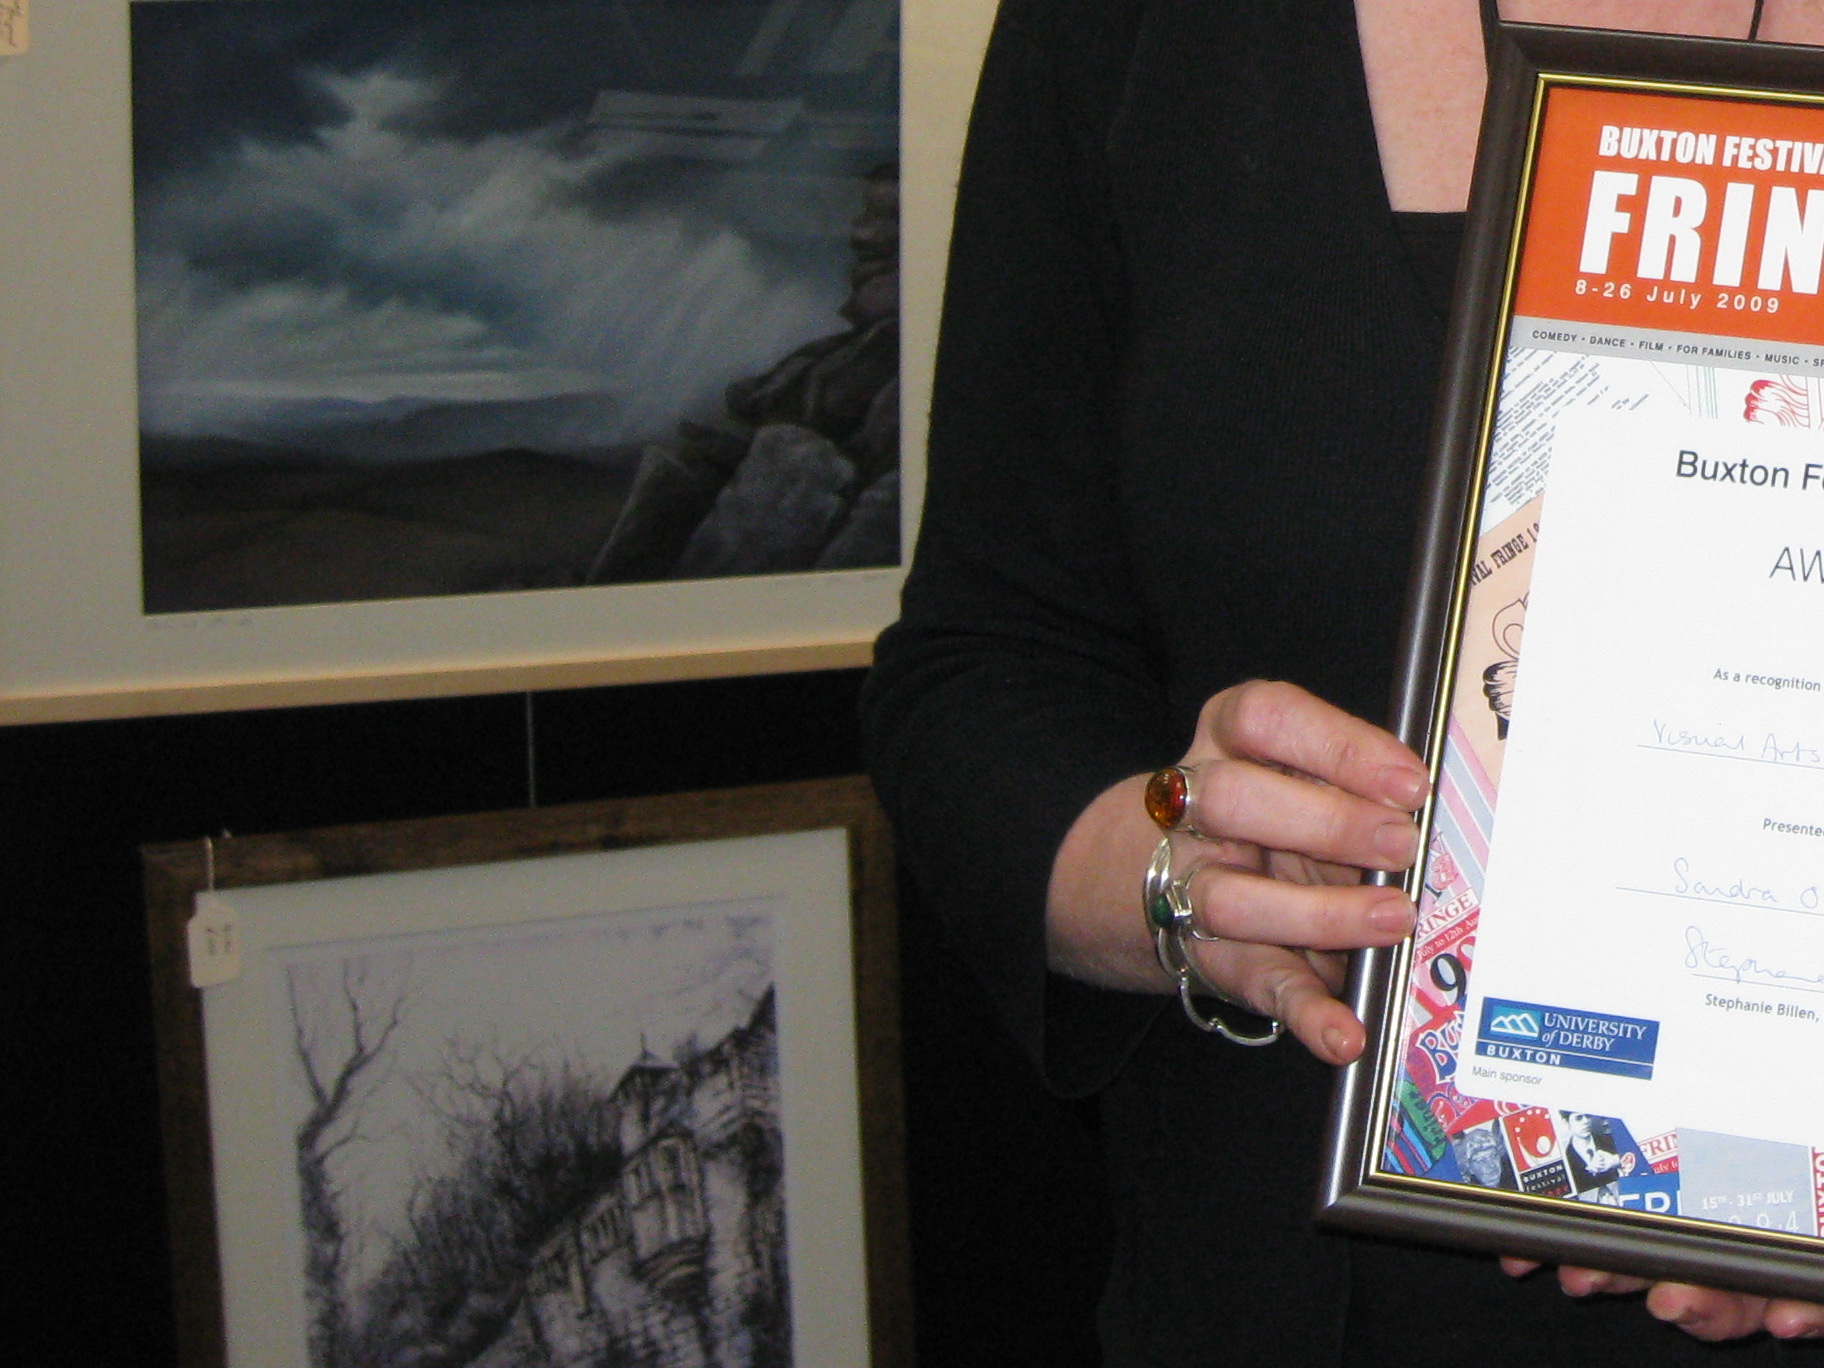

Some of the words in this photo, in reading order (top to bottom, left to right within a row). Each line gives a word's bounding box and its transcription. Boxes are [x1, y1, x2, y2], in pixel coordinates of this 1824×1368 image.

[1599, 125, 1717, 165] BUXTON
[1574, 279, 1632, 299] 8-26
[1647, 286, 1701, 309] July
[1716, 293, 1780, 313] 2009
[1532, 330, 1577, 343] COMEDY
[1590, 336, 1626, 348] DANCE
[1638, 340, 1664, 352] FILM
[1676, 344, 1699, 355] FOR
[1702, 347, 1751, 361] FAMILIES
[1764, 353, 1800, 365] MUSIC
[1675, 449, 1790, 489] Buxton
[1713, 667, 1729, 681] As
[1732, 672, 1741, 683] a
[1745, 673, 1822, 693] recognition
[1673, 857, 1777, 903] Sandra
[1704, 993, 1772, 1015] Stephanie
[1776, 1002, 1820, 1024] Billen,
[1541, 1030, 1558, 1048] of
[1558, 1032, 1616, 1053] DERBY
[1543, 1011, 1647, 1041] UNIVERSITY
[1486, 1044, 1562, 1065] BUXTON
[1472, 1065, 1498, 1080] Main
[1499, 1071, 1543, 1087] sponsor
